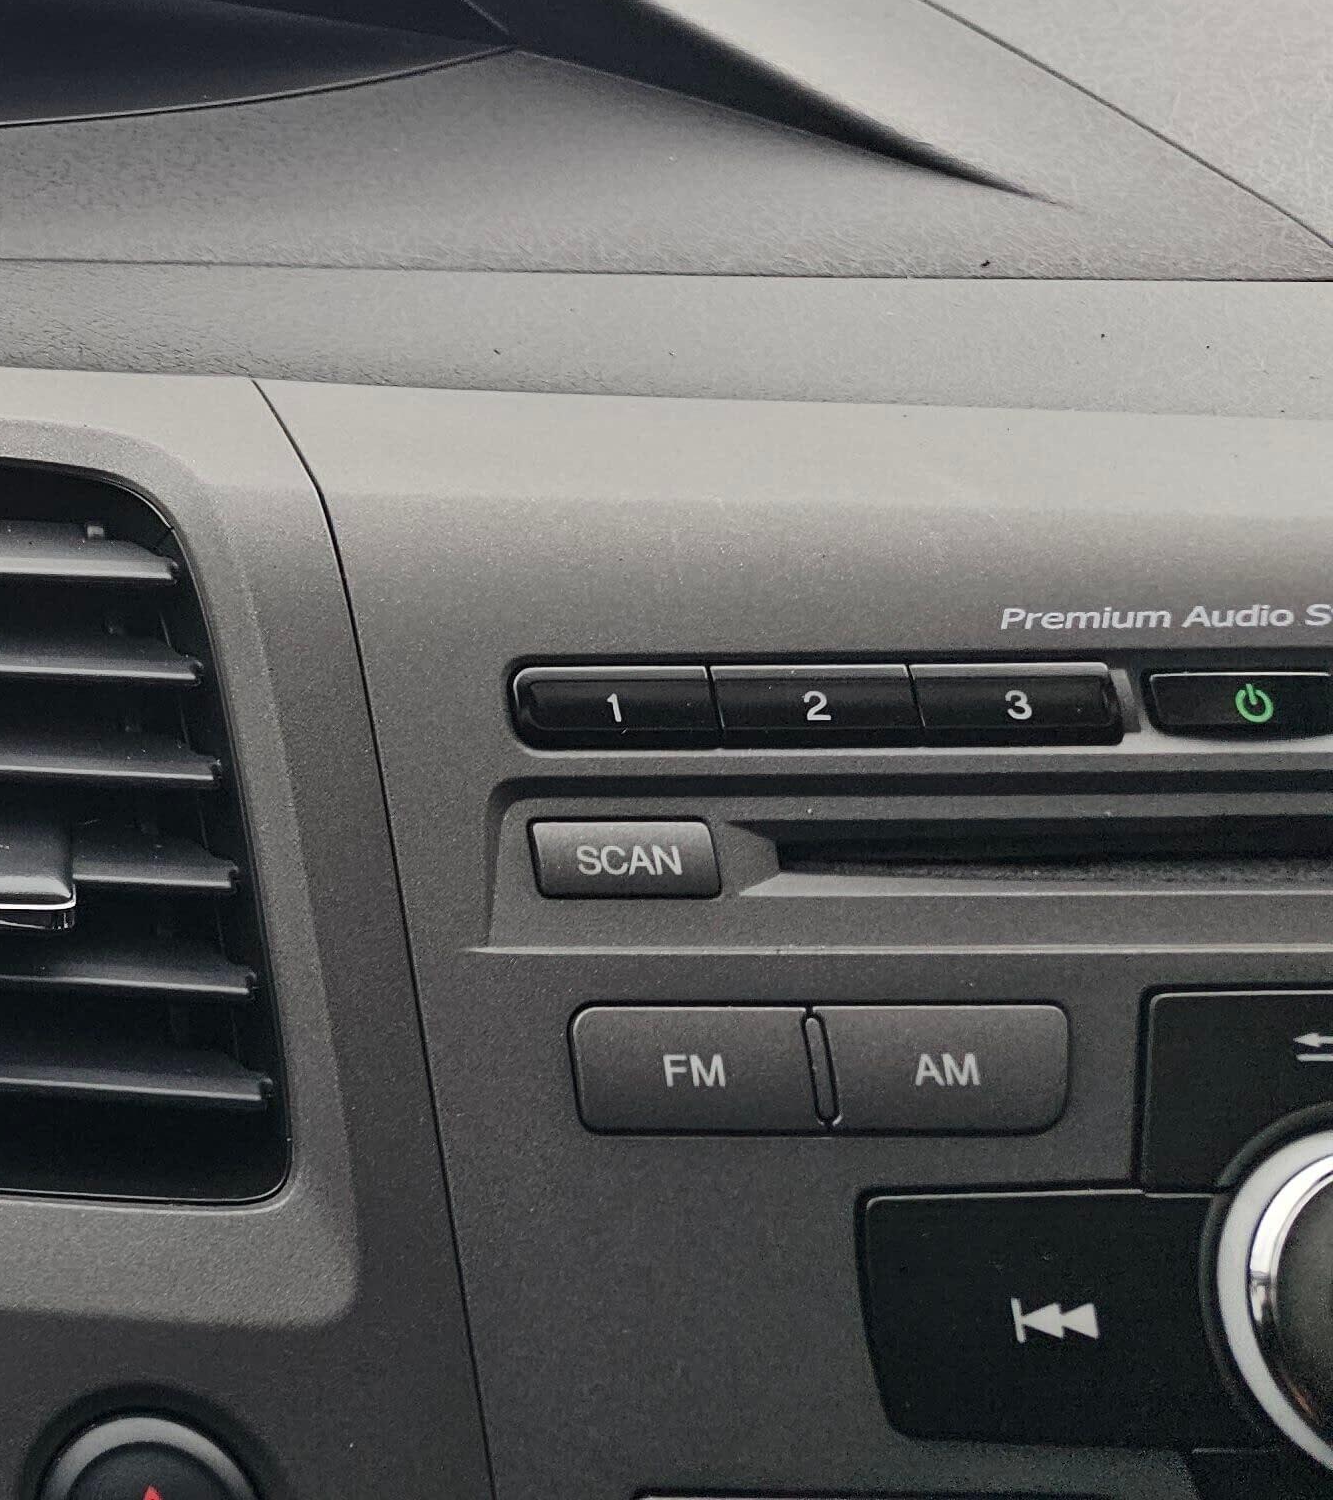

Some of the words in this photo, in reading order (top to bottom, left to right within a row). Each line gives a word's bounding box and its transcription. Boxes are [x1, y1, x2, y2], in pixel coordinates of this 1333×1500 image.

[1000, 605, 1172, 630] Premium
[1182, 603, 1295, 629] Audio
[1304, 602, 1333, 627] S
[607, 693, 622, 723] 1
[803, 690, 832, 721] 2
[1004, 689, 1033, 720] 3
[576, 844, 682, 876] SCAN
[662, 1053, 726, 1088] FM
[914, 1052, 981, 1087] AM
